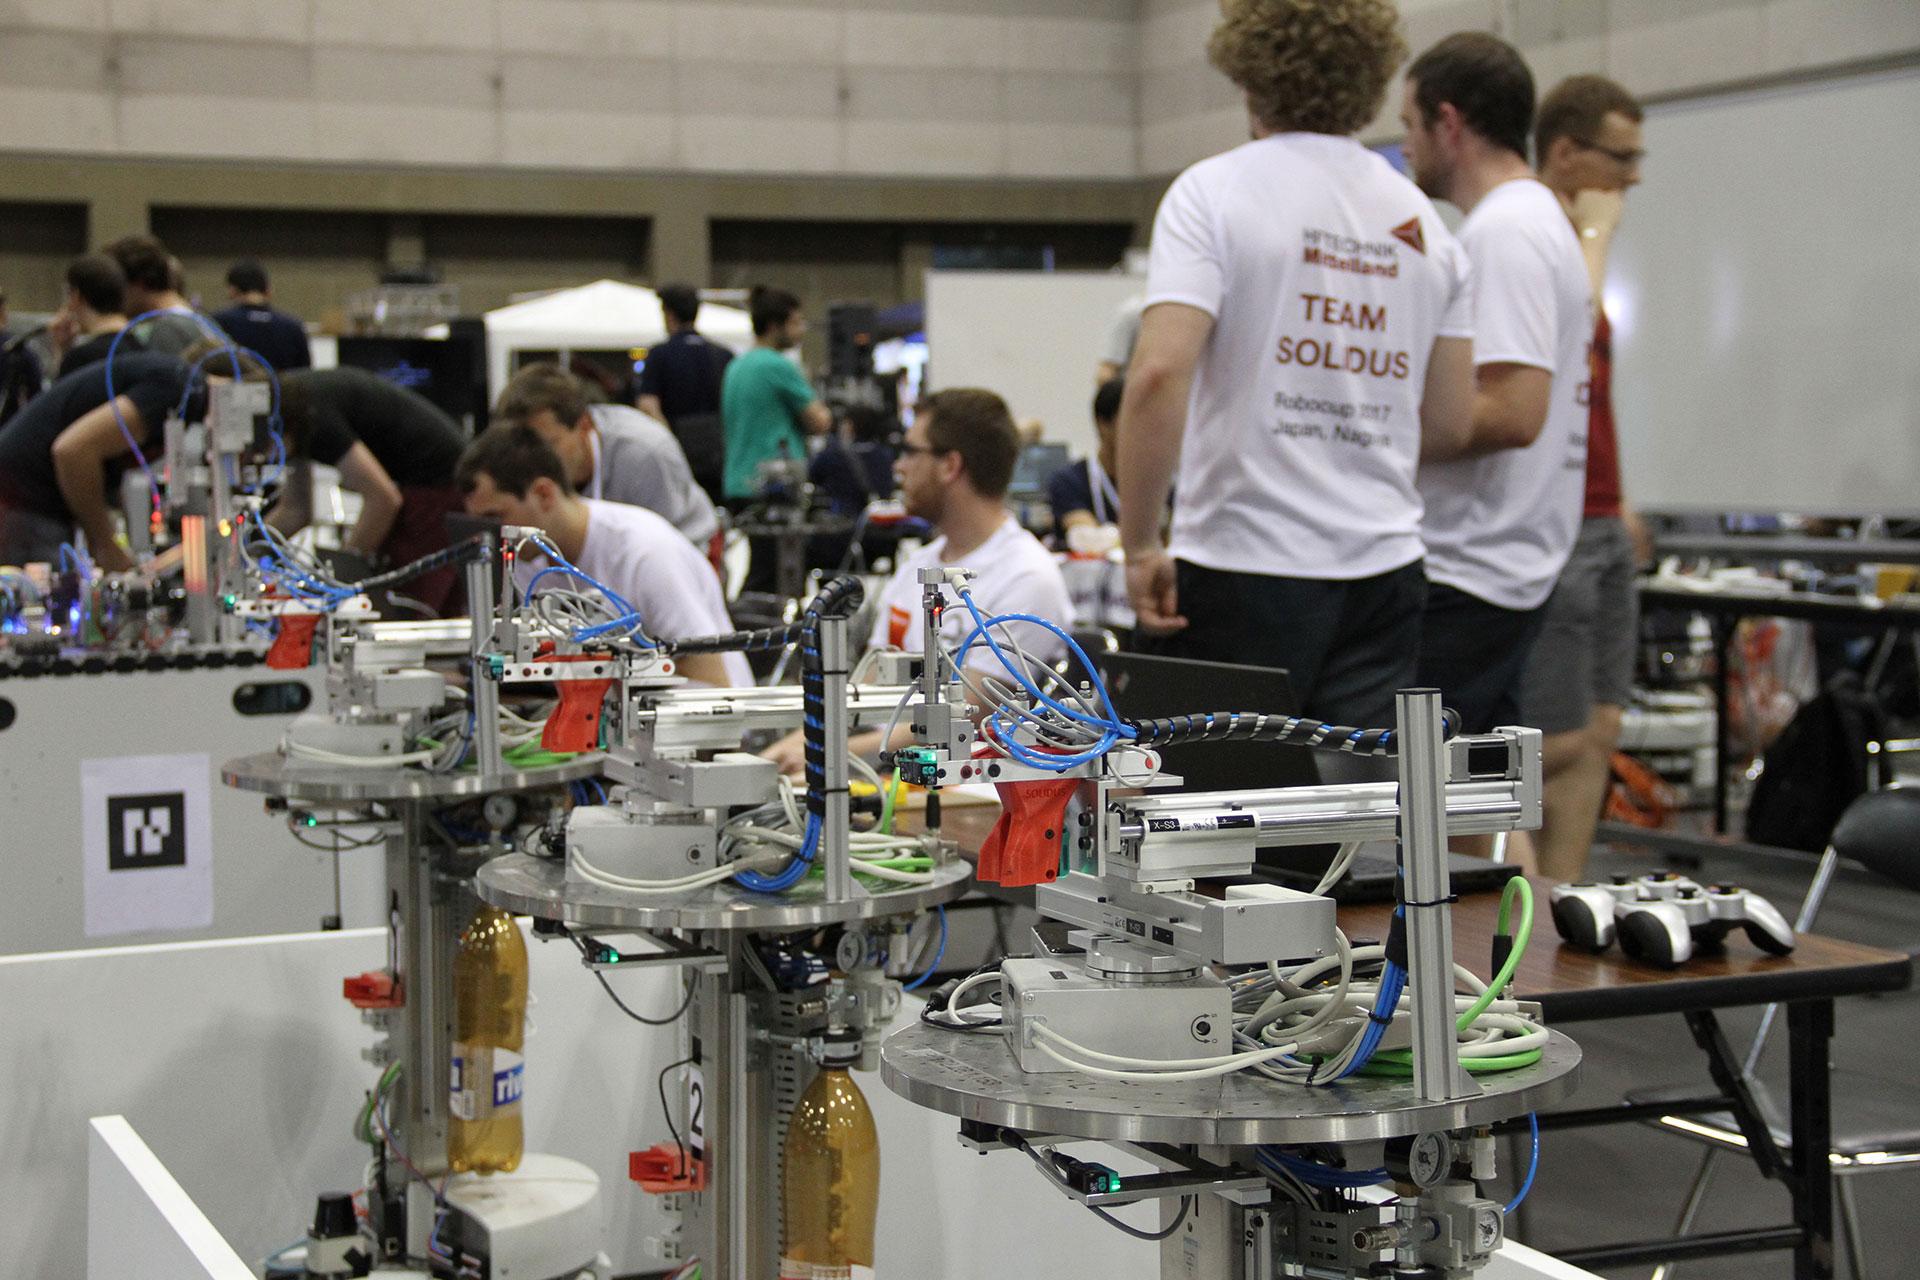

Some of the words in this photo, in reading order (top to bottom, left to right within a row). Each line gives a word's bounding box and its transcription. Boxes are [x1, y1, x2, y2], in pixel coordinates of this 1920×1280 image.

[1300, 293, 1386, 331] TEAM
[1332, 423, 1391, 449] Naga
[1153, 821, 1176, 829] X-S3
[691, 1081, 703, 1138] 2
